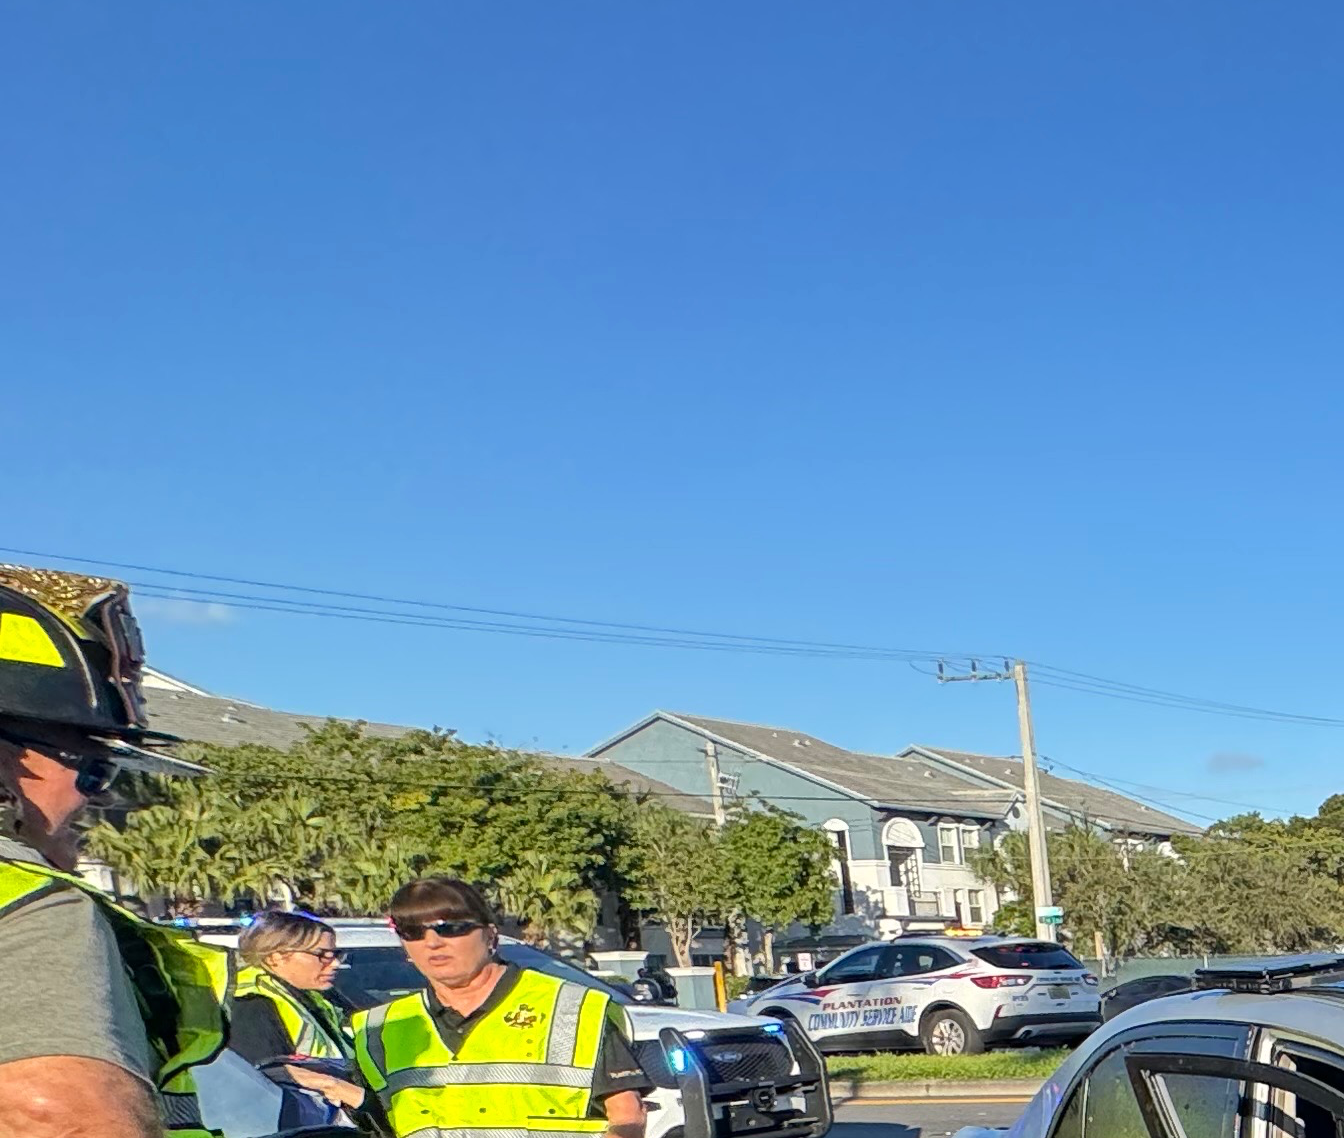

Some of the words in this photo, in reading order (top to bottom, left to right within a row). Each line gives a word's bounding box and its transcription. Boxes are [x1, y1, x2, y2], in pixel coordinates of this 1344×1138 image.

[823, 996, 902, 1011] PLANTATION
[808, 1011, 860, 1031] COMMUNITY
[861, 1007, 897, 1026] SERVICE
[900, 1005, 918, 1023] AIDE
